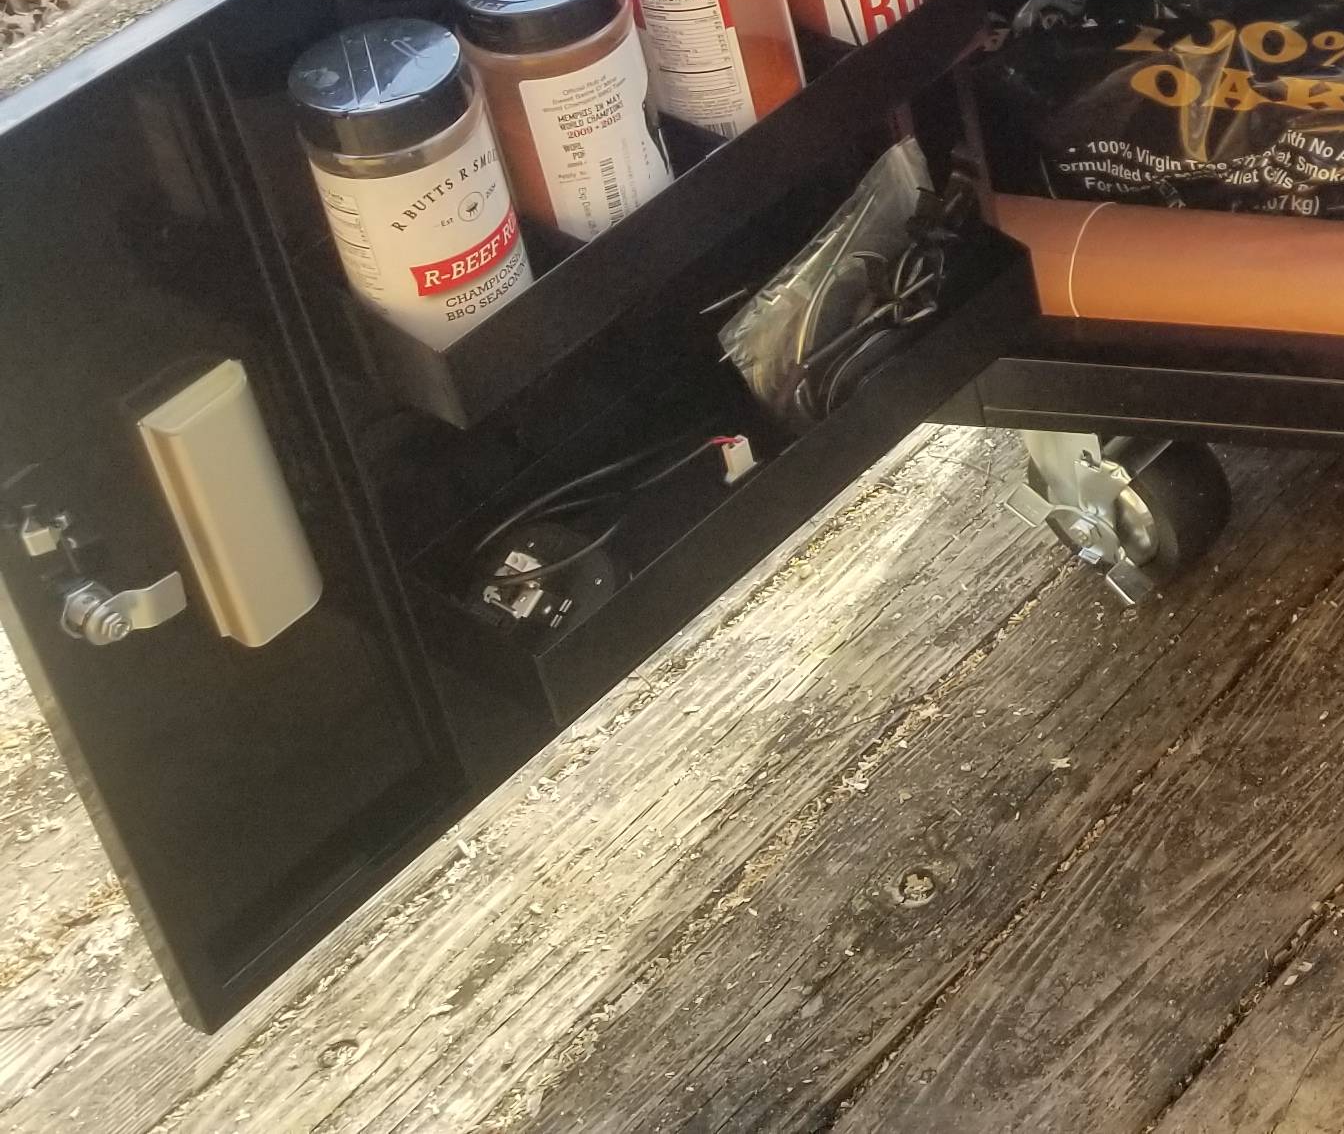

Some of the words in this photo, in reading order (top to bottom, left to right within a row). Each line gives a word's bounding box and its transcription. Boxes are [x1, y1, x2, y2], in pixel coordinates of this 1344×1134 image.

[567, 126, 594, 139] 2009
[1087, 141, 1133, 160] 100%
[1136, 145, 1182, 173] Virgin
[1309, 138, 1334, 157] No
[1058, 159, 1142, 182] ormulated
[391, 221, 408, 232] R
[402, 178, 454, 220] BUTTS
[459, 168, 469, 181] R
[424, 235, 502, 288] R-BEEF
[503, 218, 516, 245] RU
[445, 304, 476, 322] BBQ
